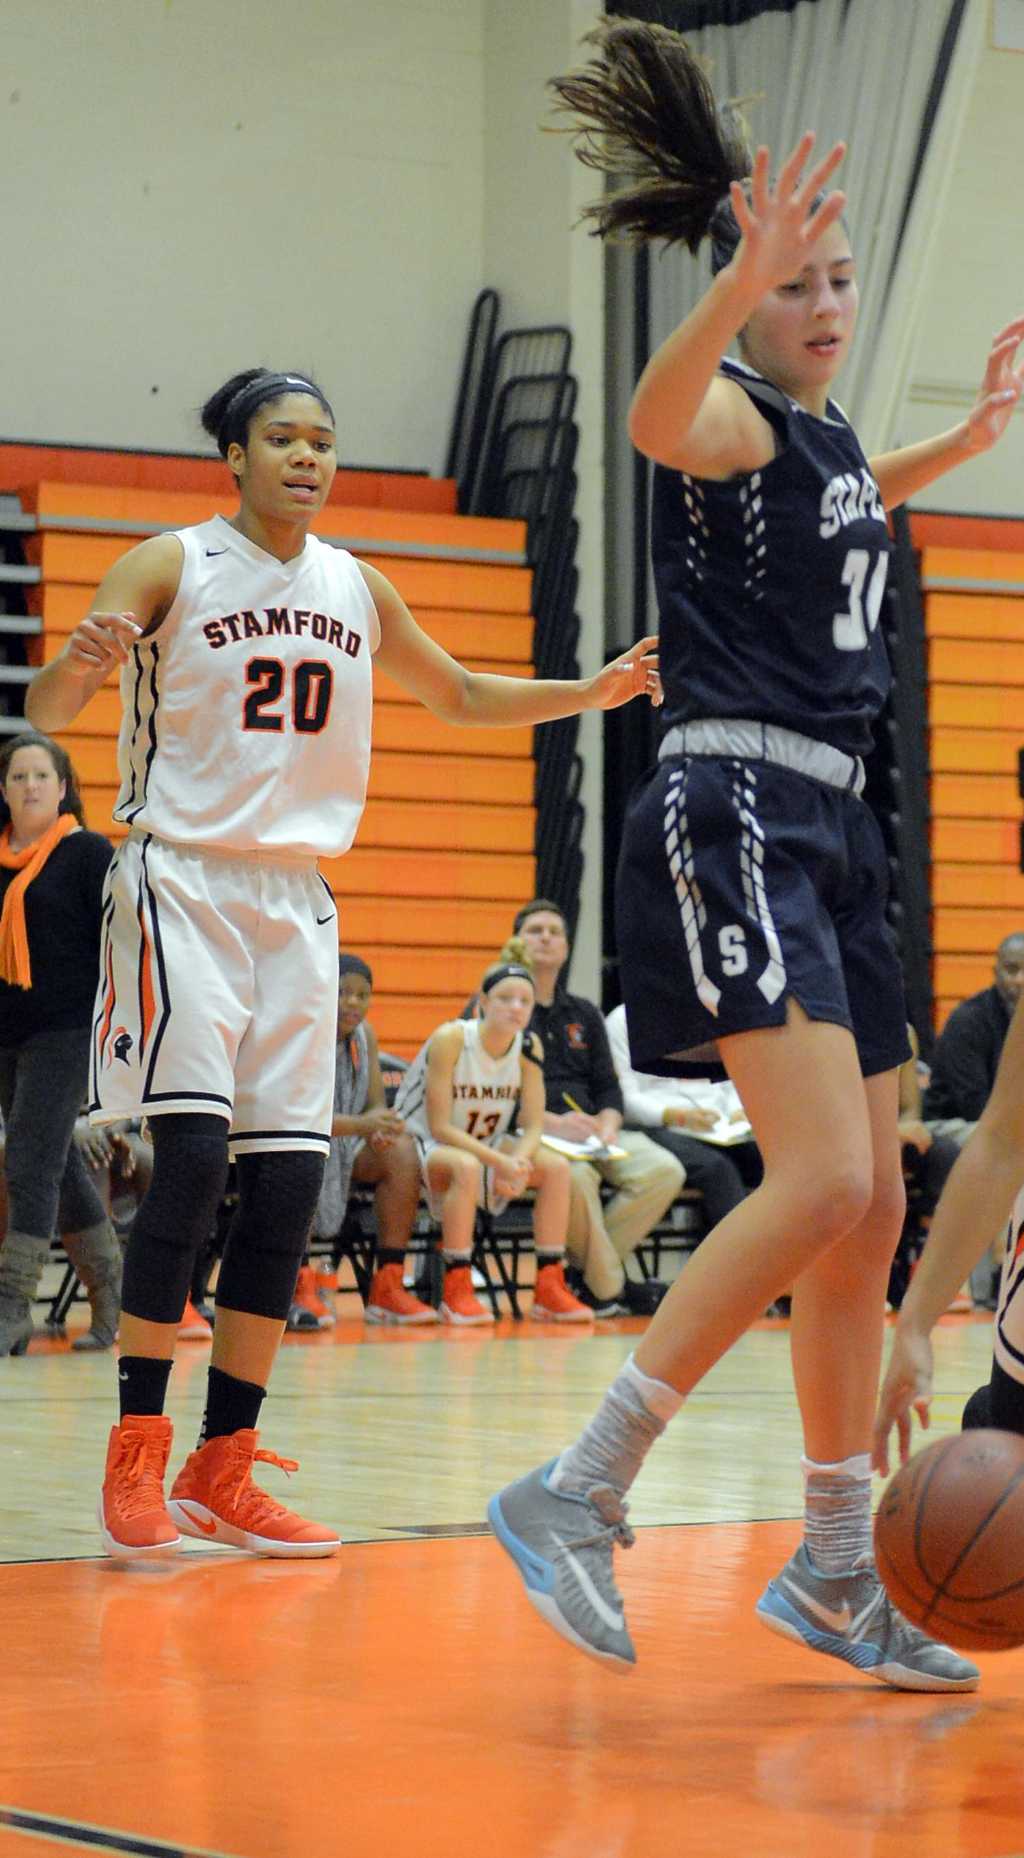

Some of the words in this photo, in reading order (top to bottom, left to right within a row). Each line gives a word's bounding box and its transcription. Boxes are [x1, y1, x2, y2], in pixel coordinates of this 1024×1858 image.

[202, 607, 363, 659] STAMFORD
[241, 655, 335, 736] 20
[718, 923, 749, 977] S
[465, 1110, 502, 1140] 13
